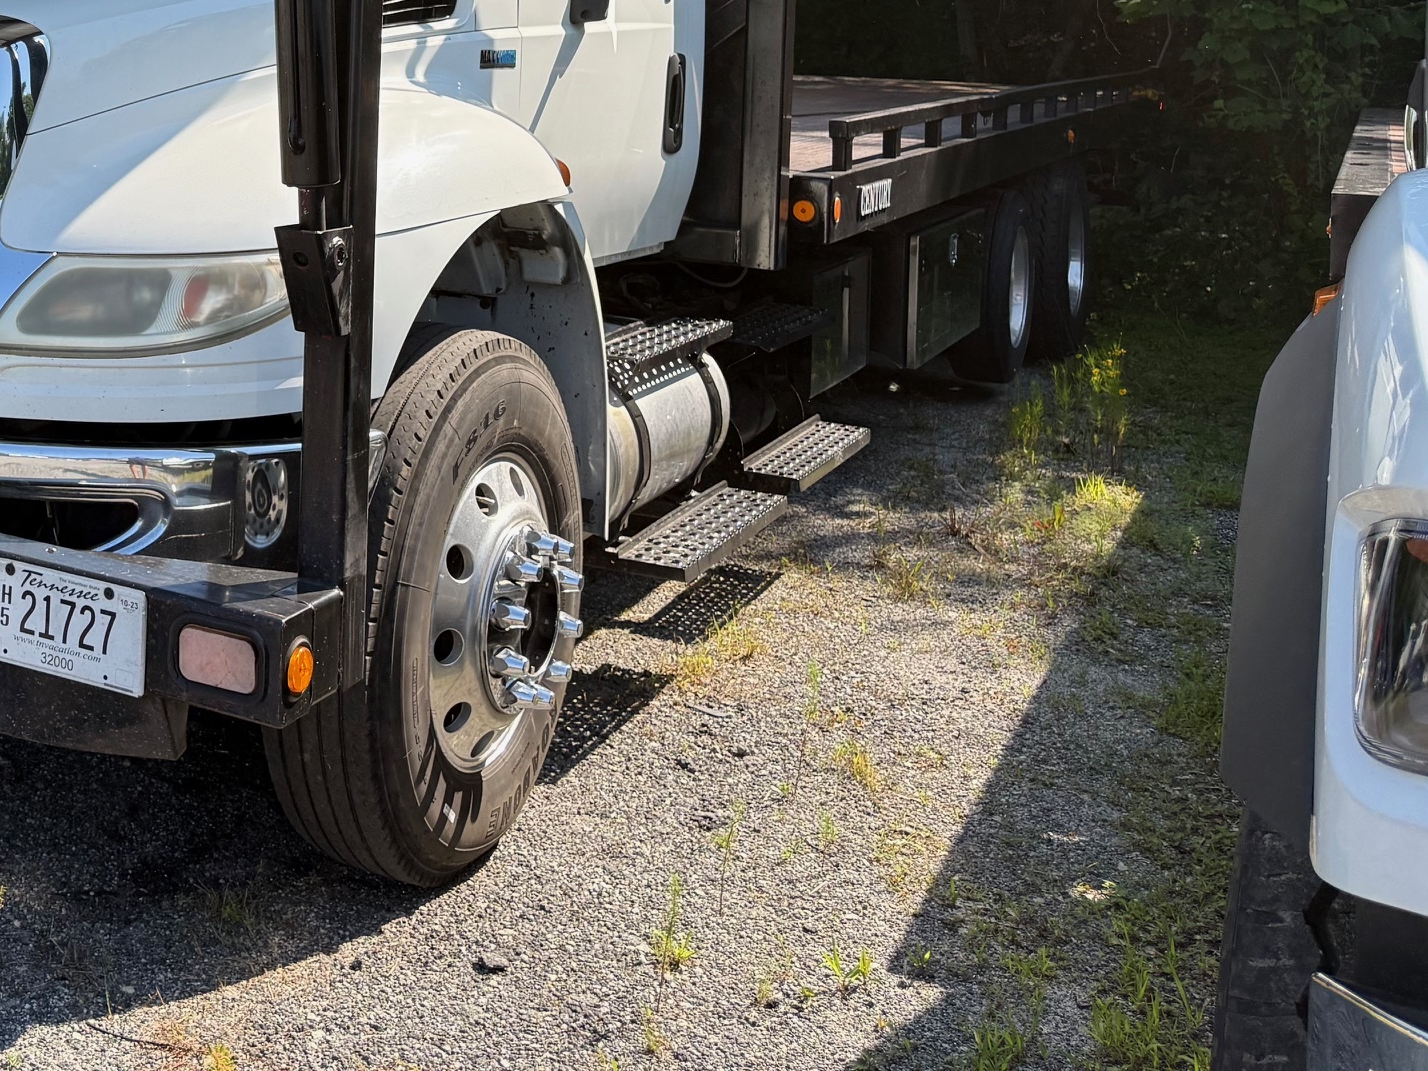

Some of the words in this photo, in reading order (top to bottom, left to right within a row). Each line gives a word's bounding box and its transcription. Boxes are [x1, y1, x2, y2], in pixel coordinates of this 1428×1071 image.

[860, 178, 892, 217] CENTURY
[20, 569, 100, 602] Tennessee
[19, 589, 117, 656] 21727
[12, 633, 102, 664] www.tnvacation.com
[40, 651, 74, 672] 32000
